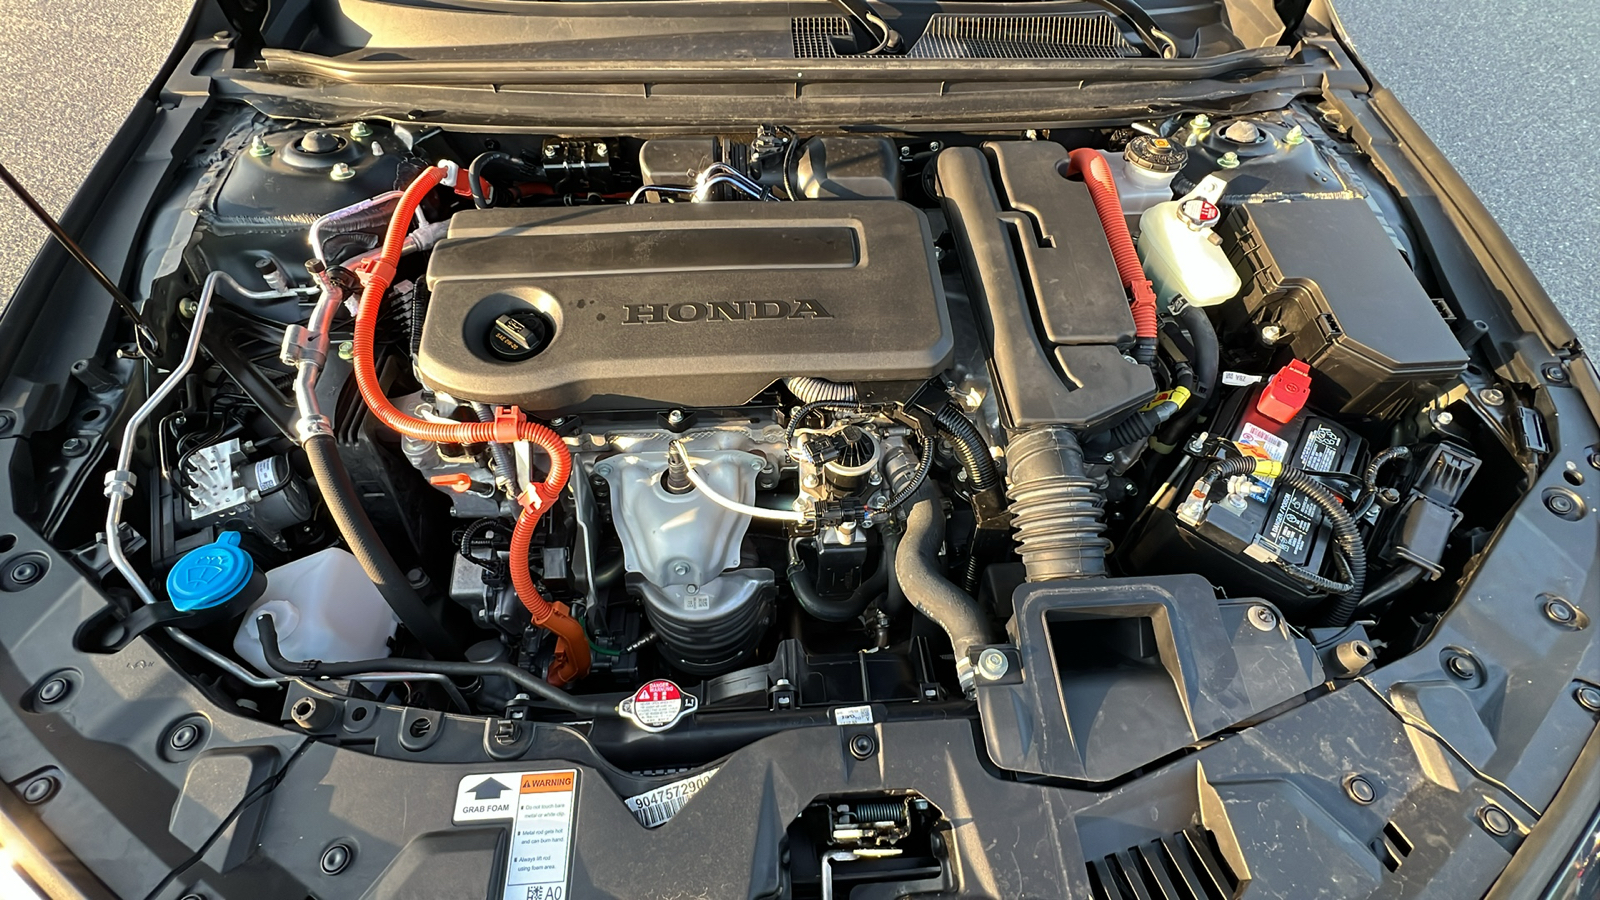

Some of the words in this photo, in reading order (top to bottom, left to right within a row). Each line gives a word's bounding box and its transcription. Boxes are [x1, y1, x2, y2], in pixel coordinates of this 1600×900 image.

[621, 298, 835, 326] HONDA
[1272, 512, 1284, 533] DANGER
[532, 777, 571, 787] WARNING
[462, 805, 485, 814] GRAB
[487, 804, 510, 812] FOAM
[545, 886, 562, 900] A0
